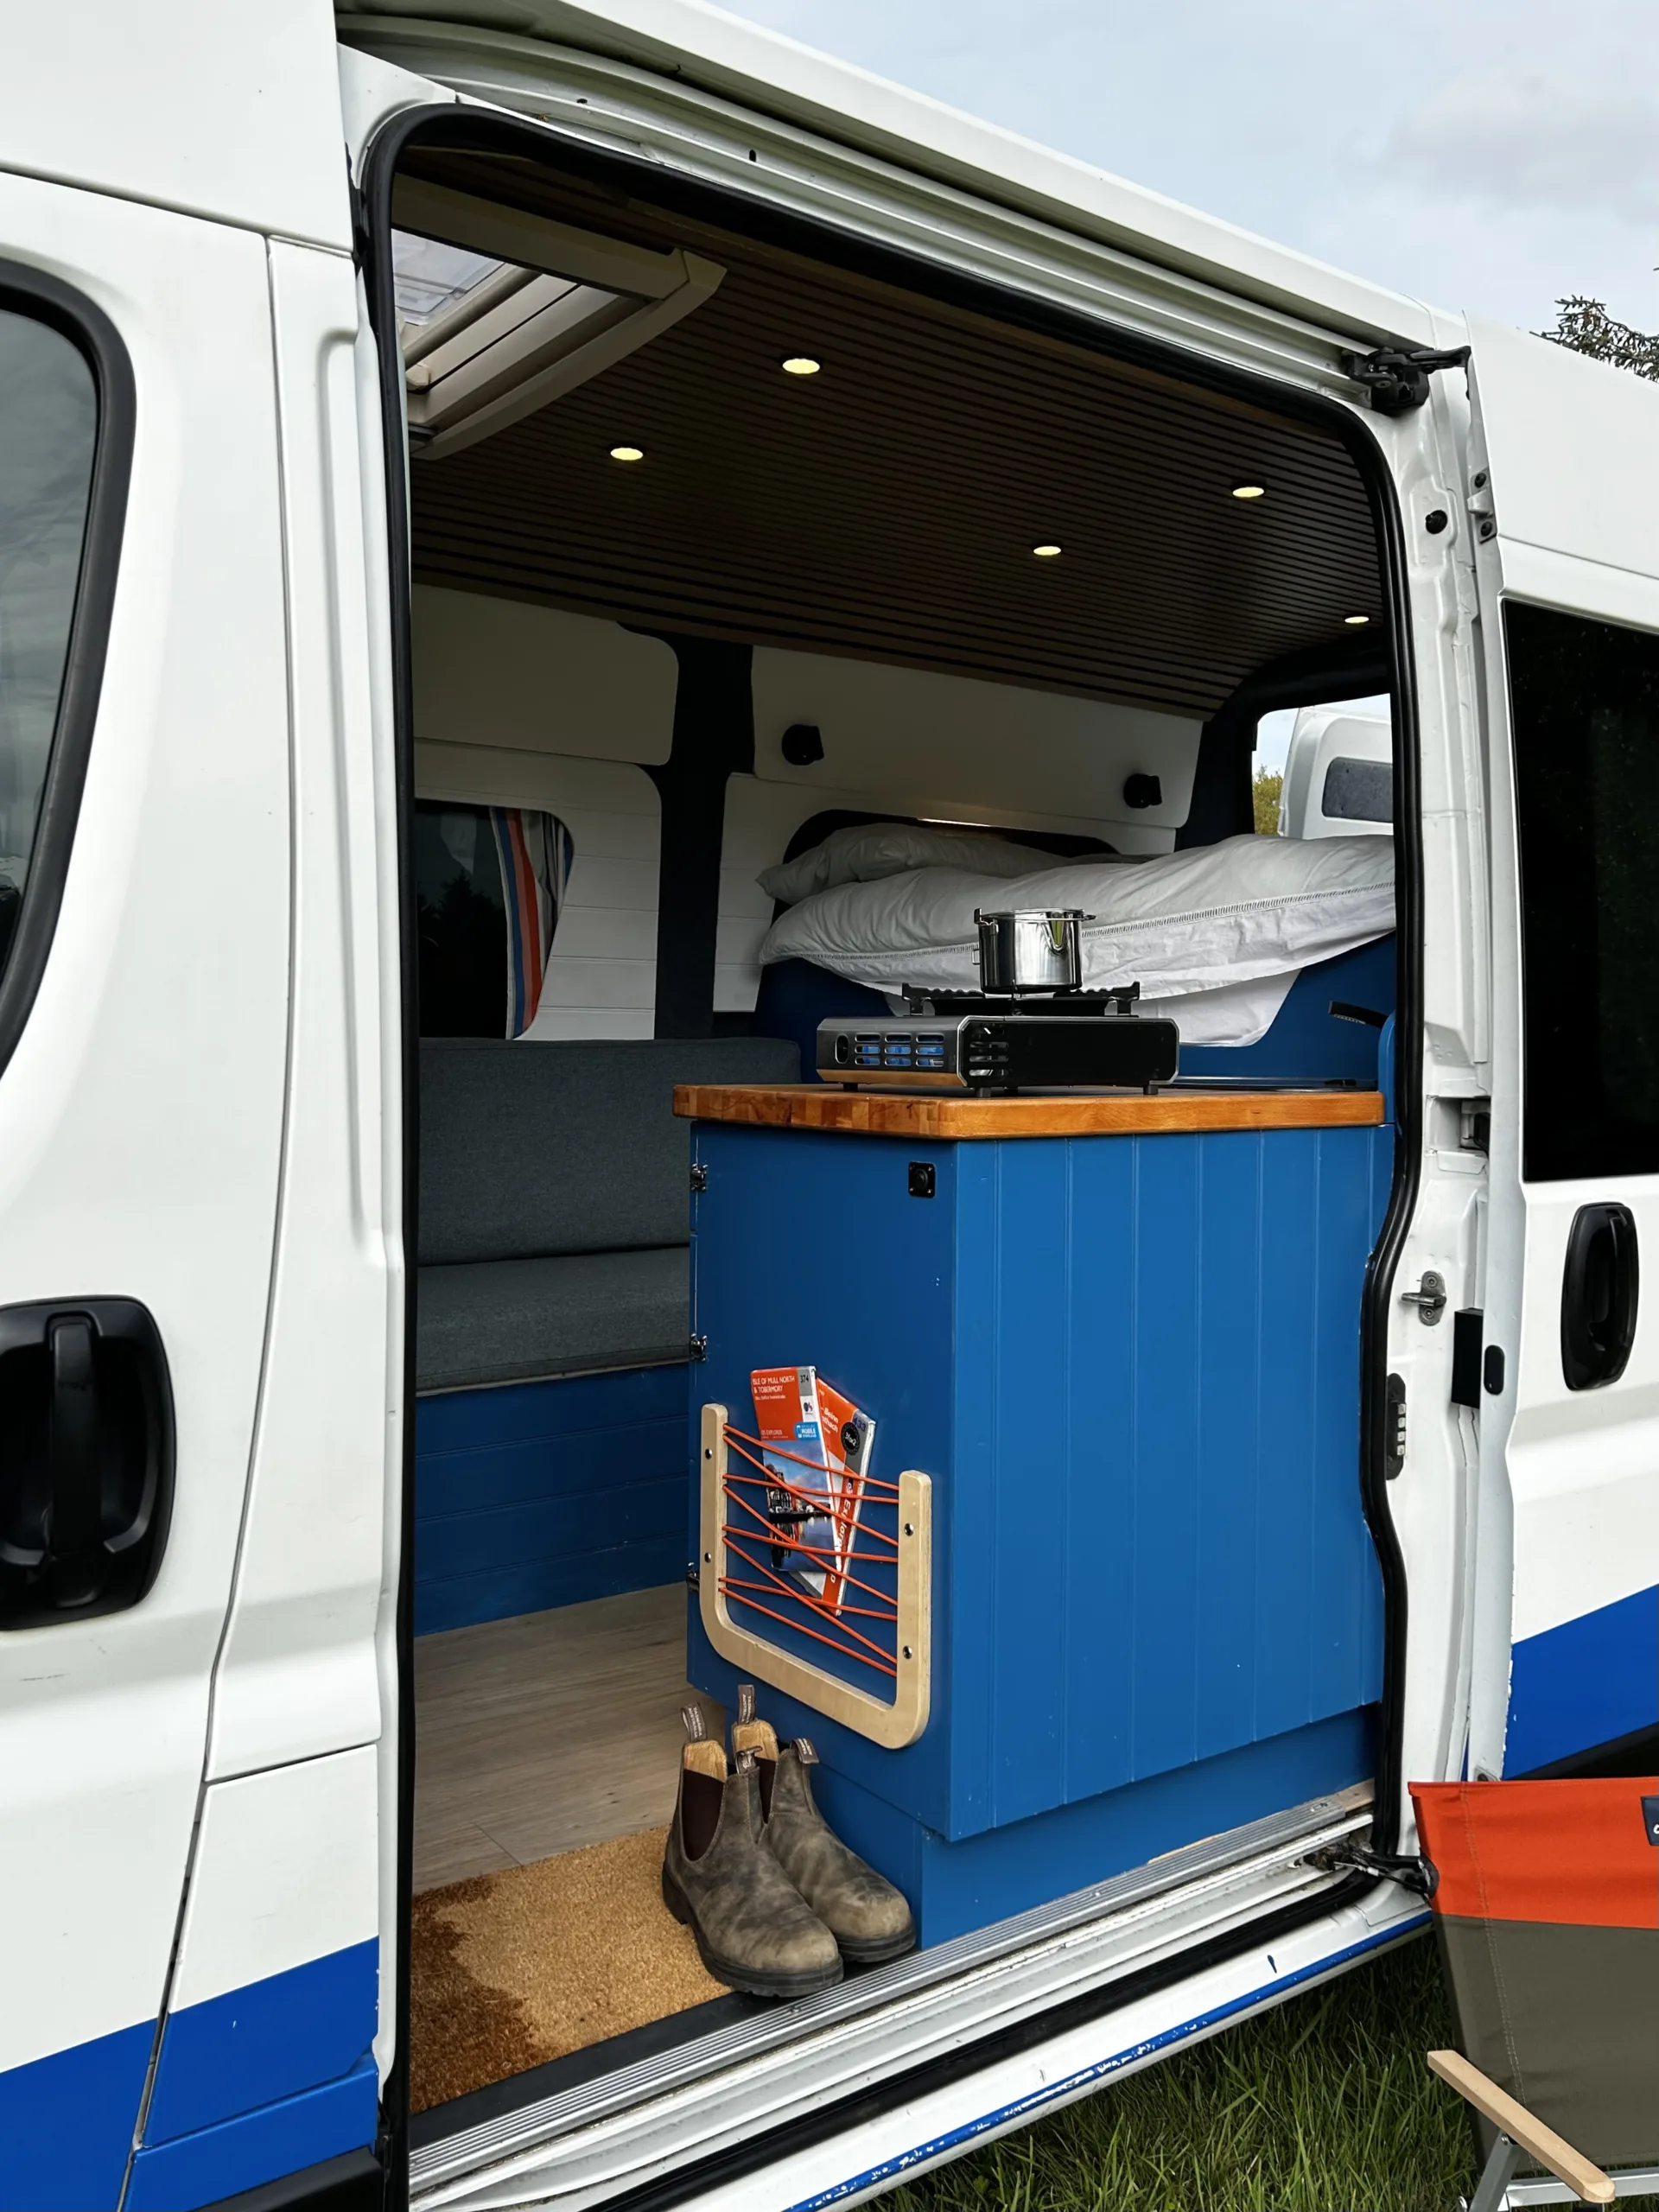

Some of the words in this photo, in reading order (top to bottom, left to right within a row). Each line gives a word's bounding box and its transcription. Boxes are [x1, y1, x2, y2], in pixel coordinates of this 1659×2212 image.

[800, 1375, 810, 1383] 374
[852, 1417, 867, 1432] 433
[688, 1707, 698, 1738] AUSTRALIA
[693, 1707, 702, 1737] TASMANIA
